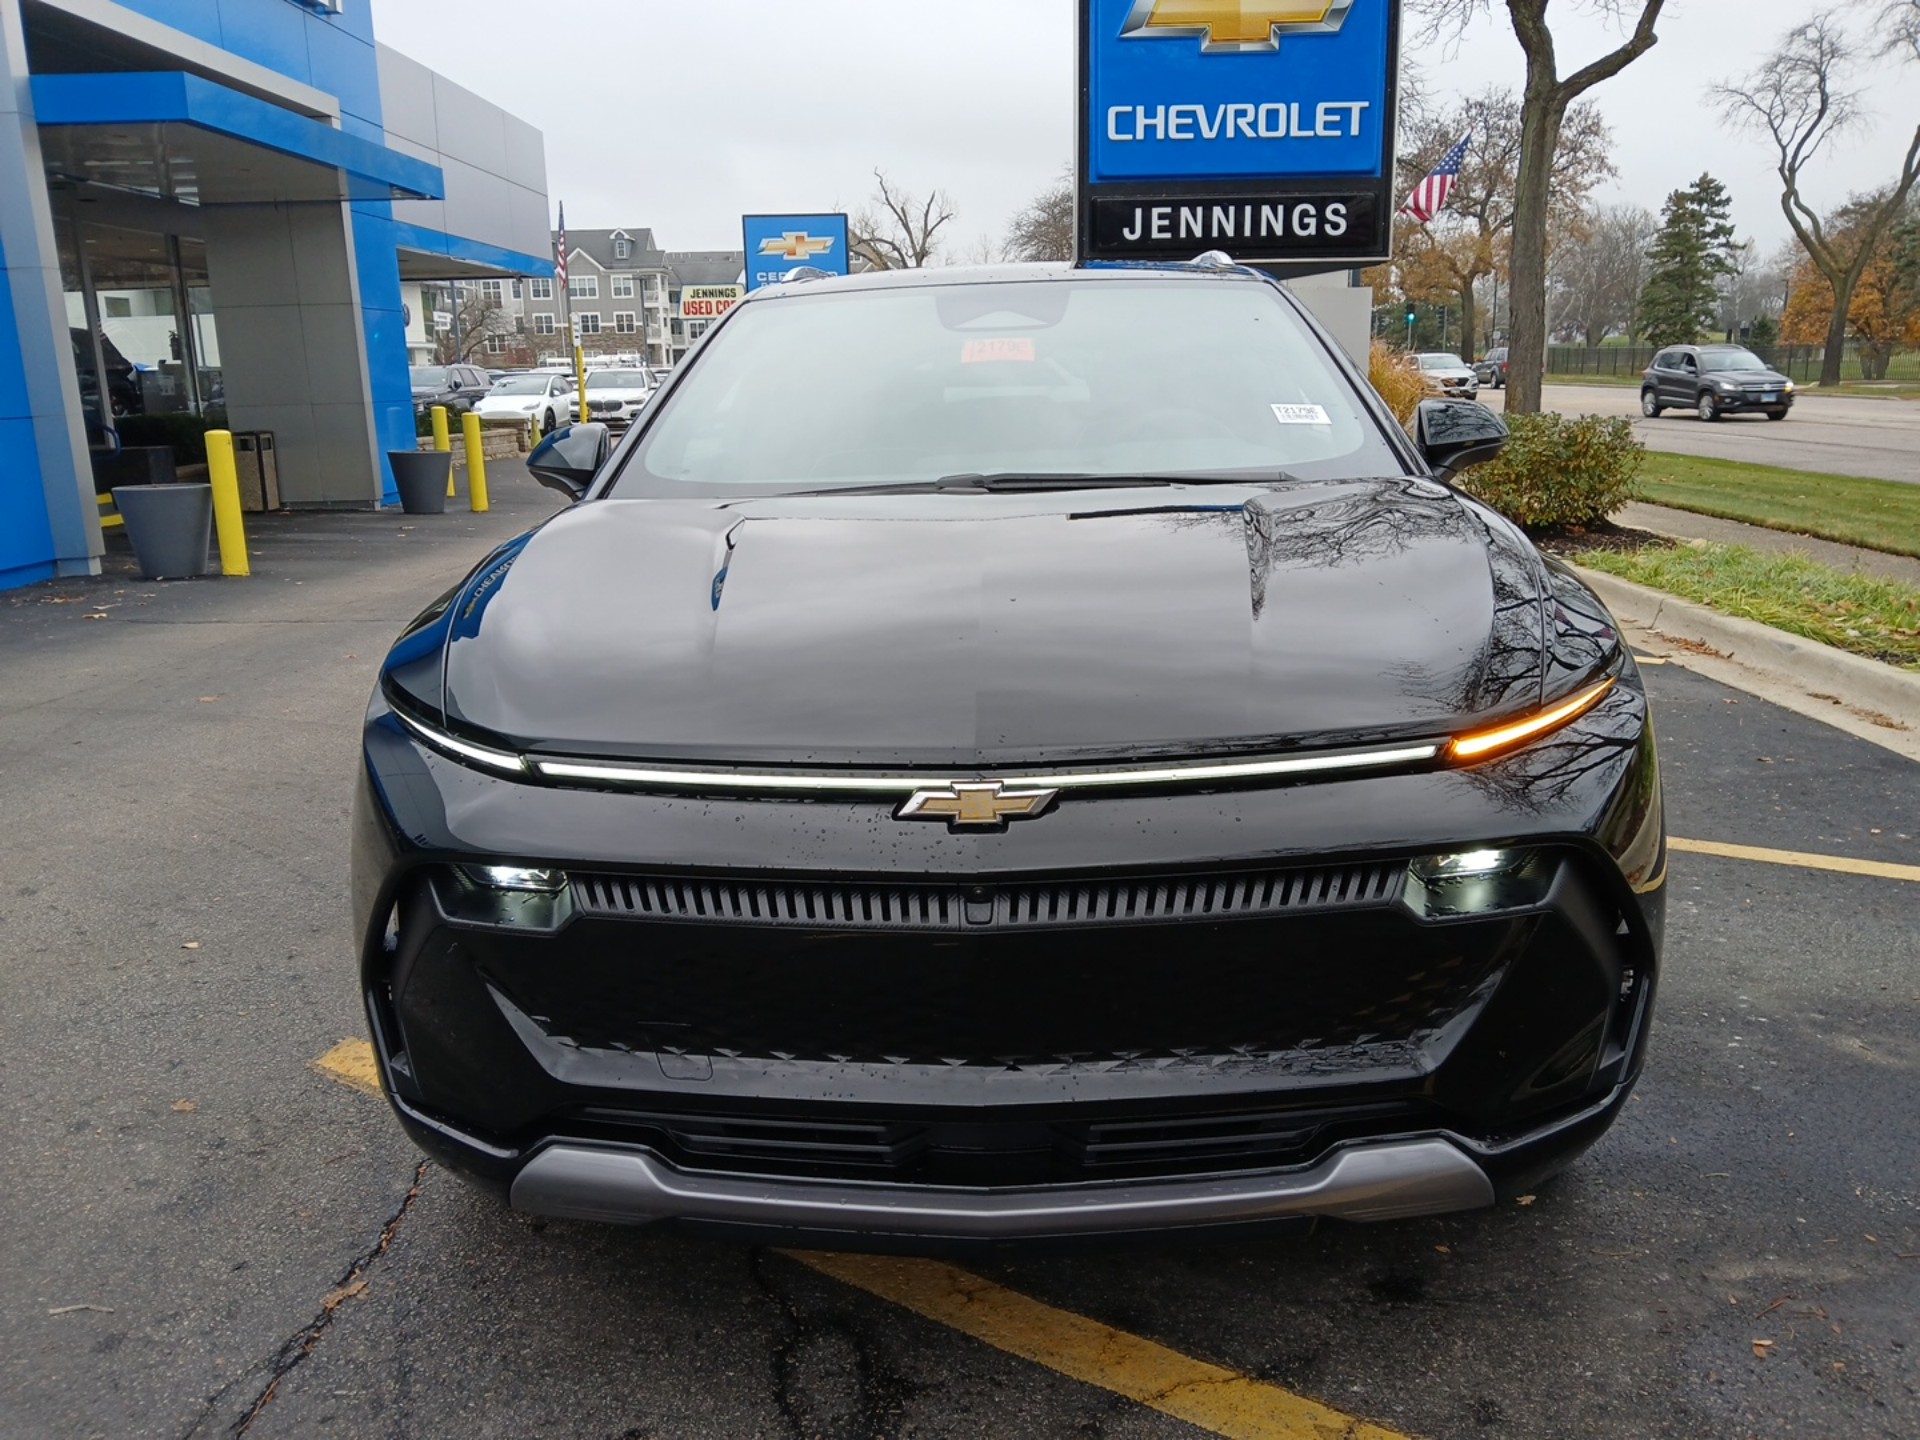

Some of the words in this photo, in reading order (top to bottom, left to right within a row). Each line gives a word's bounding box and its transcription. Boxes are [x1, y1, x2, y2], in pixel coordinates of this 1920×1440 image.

[1107, 101, 1370, 141] CHEVROLET
[1122, 202, 1348, 241] JENNINGS
[690, 287, 737, 299] JENNINGS
[683, 300, 713, 316] USED
